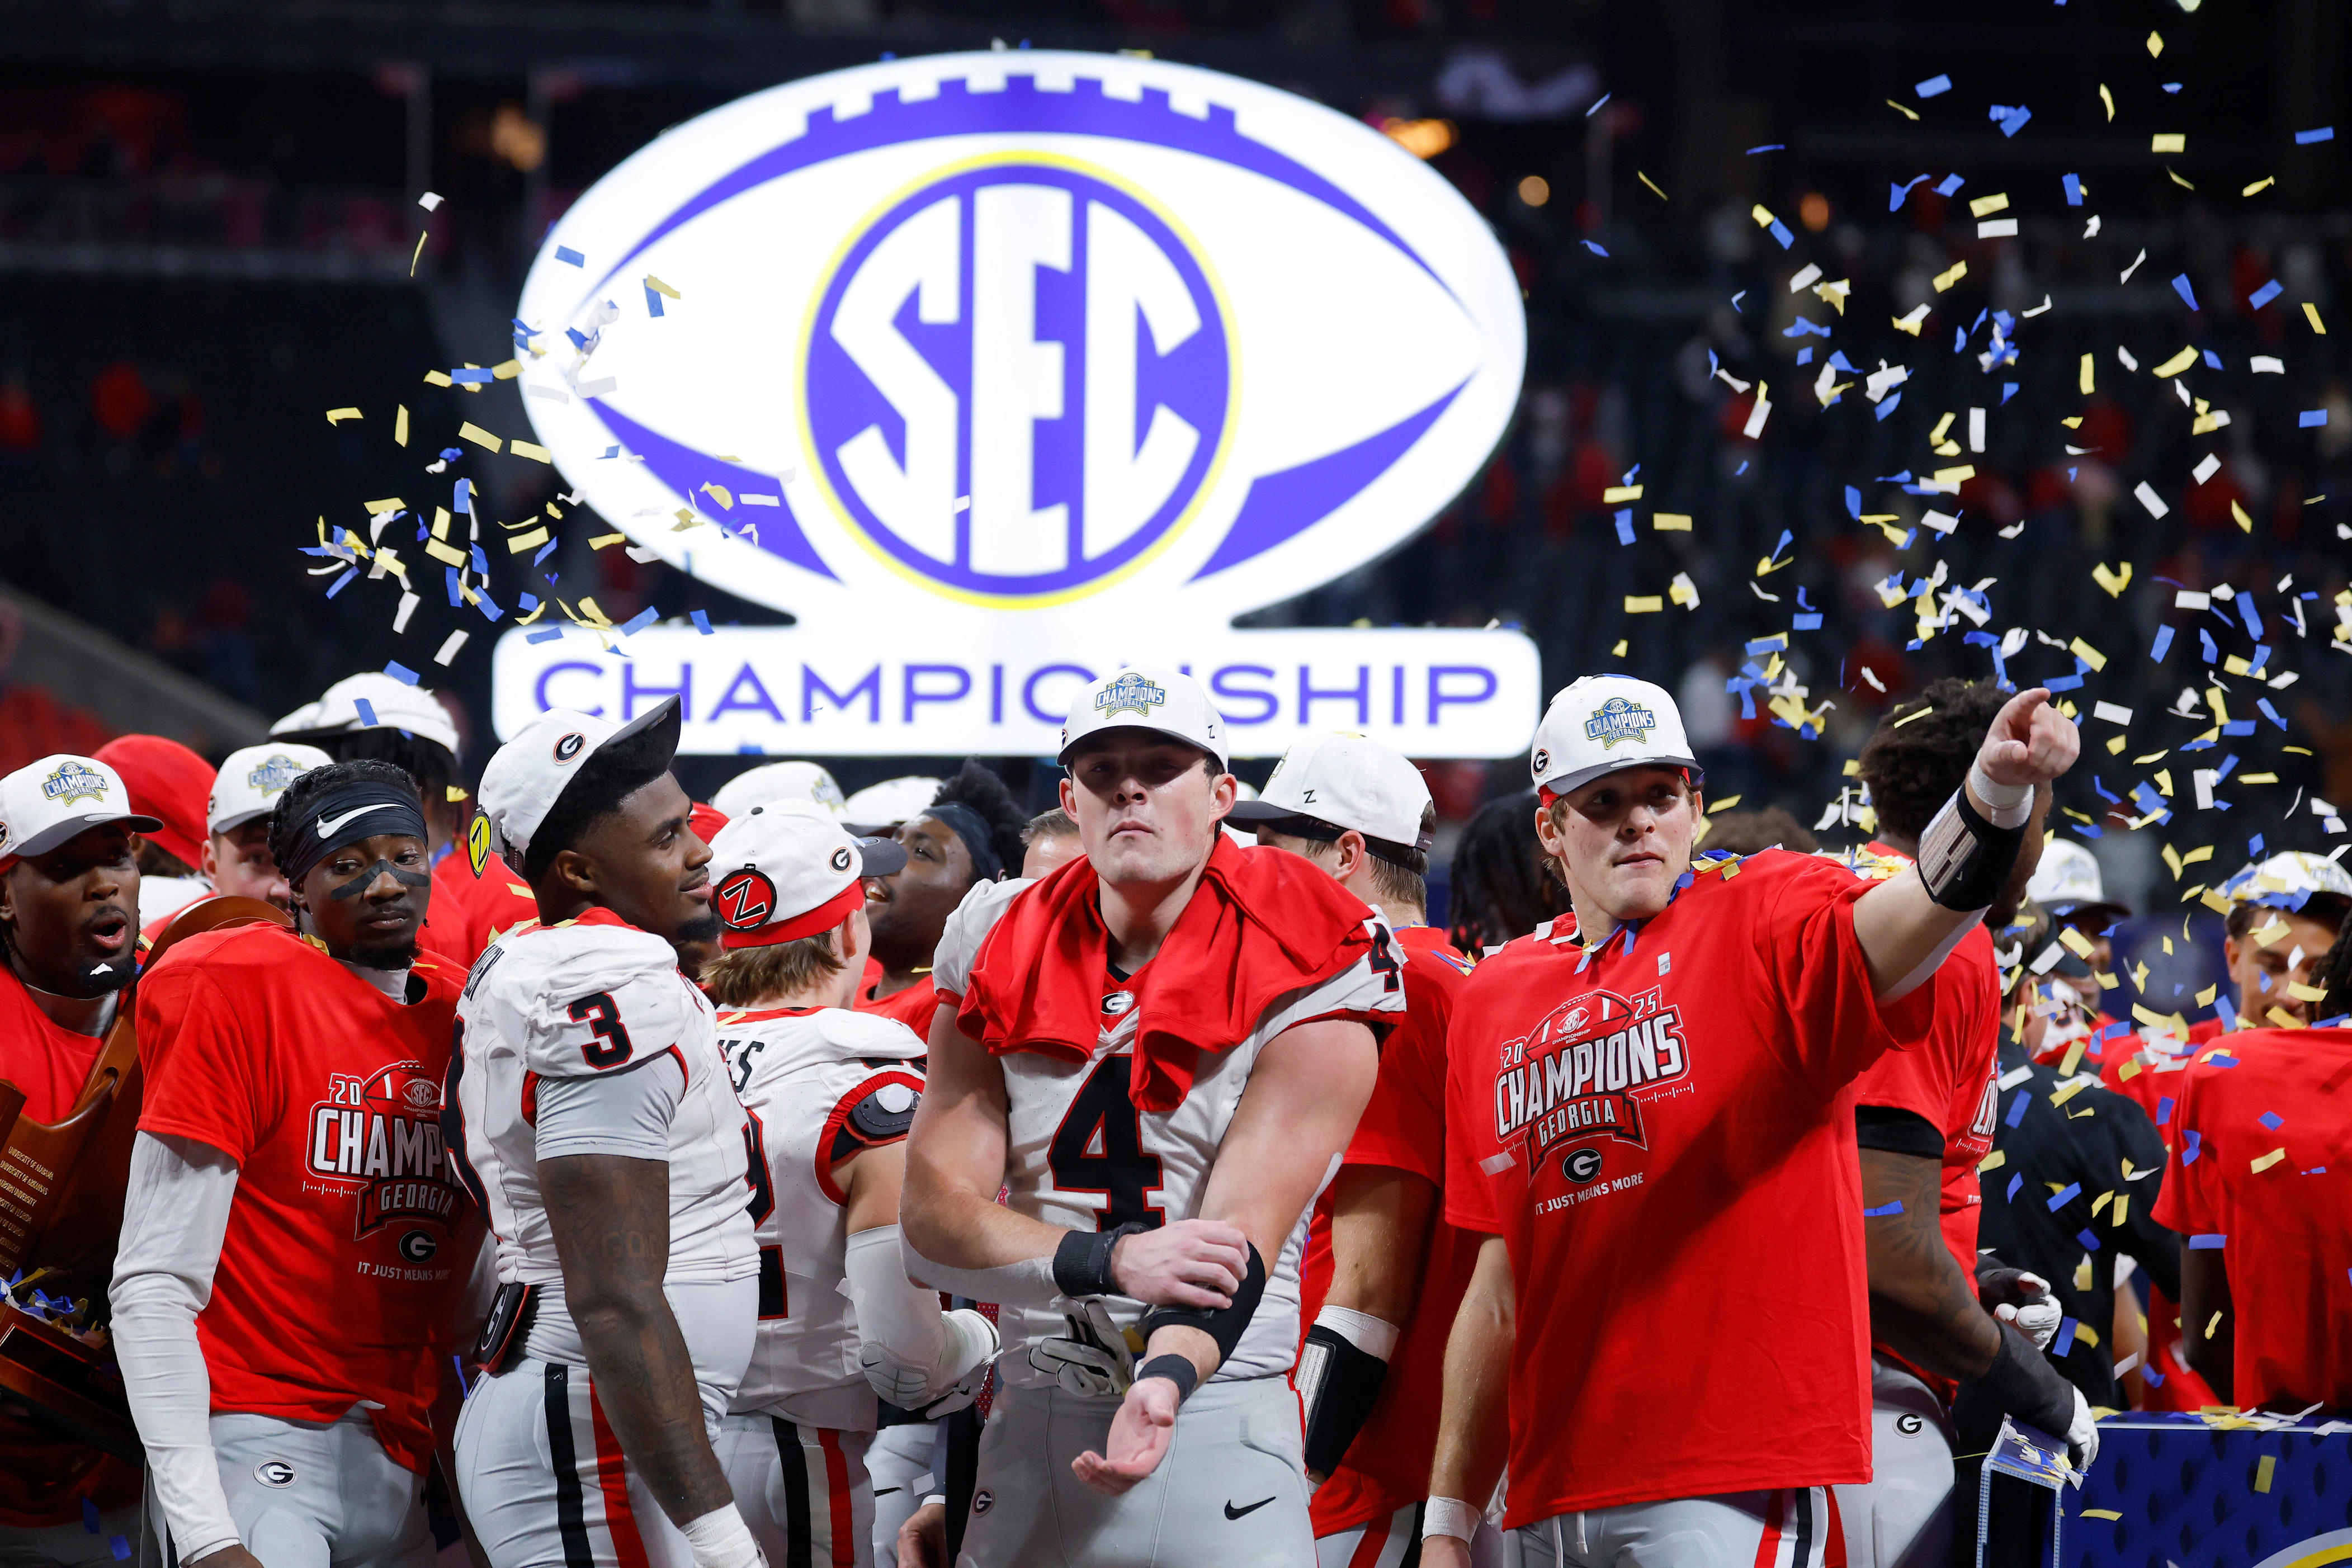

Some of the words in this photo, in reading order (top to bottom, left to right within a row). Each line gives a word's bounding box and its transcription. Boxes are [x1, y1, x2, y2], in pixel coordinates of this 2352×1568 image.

[830, 183, 1201, 576] SEC
[1123, 676, 1137, 686] SEC
[1096, 687, 1165, 709] CHAMPIONS
[1111, 700, 1143, 709] FOOTBALL
[1611, 701, 1625, 712] SEC
[1208, 725, 1215, 739] Z
[1586, 711, 1655, 736] CHAMPIONS
[1608, 728, 1641, 740] FOOTBALL
[44, 773, 108, 797] CHAMPIONS
[68, 787, 98, 799] FOOTBALL
[1303, 789, 1316, 804] Z
[471, 819, 489, 870] Z
[721, 877, 767, 923] Z
[1369, 922, 1400, 993] 4
[1634, 991, 1657, 1022] 25
[567, 991, 634, 1071] 3
[1552, 1029, 1591, 1045] CHAMPIONSHIP
[1503, 1041, 1524, 1069] 20
[1497, 1013, 1683, 1137] CHAMPIONS
[334, 1080, 361, 1107] 20
[413, 1084, 430, 1106] SEC
[403, 1105, 439, 1115] CHAMPIONSHI
[1538, 1098, 1616, 1148] GEORGIA
[313, 1108, 463, 1188] CHAMPI
[1047, 1053, 1166, 1232] 4
[8, 1146, 32, 1165] UNIVERSITY
[0, 1160, 23, 1179] UNIVERSITY
[26, 1178, 49, 1196] ARKANSAS
[13, 1186, 37, 1207] UNIVERSITY
[380, 1183, 454, 1218] GEORGIA
[1547, 1193, 1575, 1212] JUST
[1578, 1182, 1609, 1203] MEANS
[1612, 1172, 1644, 1192] MORE
[357, 1261, 370, 1274] IT
[371, 1264, 402, 1281] JUST
[403, 1269, 433, 1281] MEANS
